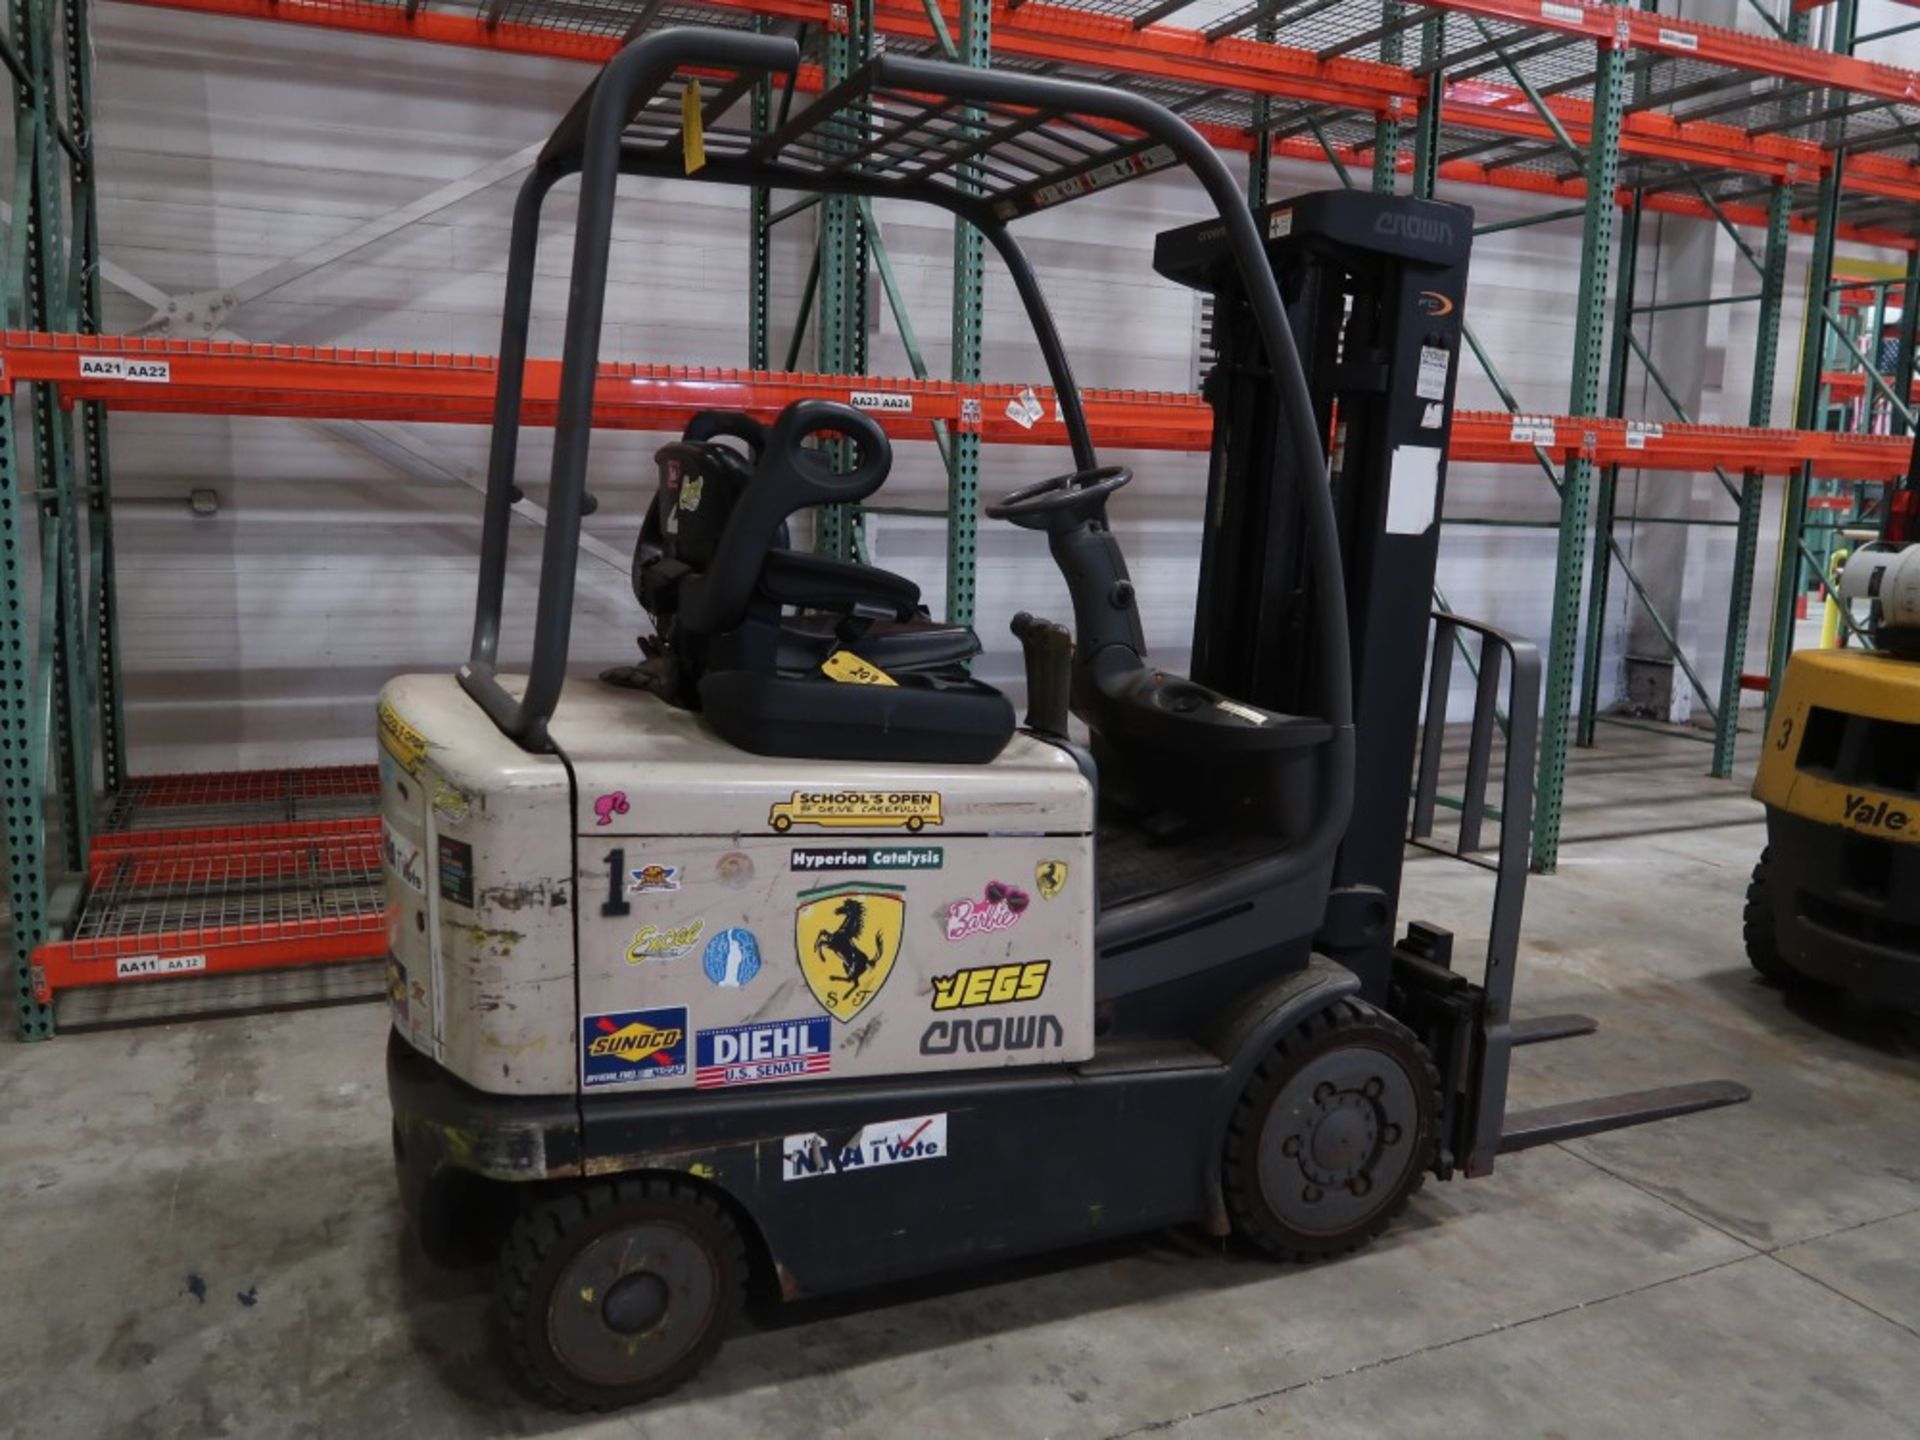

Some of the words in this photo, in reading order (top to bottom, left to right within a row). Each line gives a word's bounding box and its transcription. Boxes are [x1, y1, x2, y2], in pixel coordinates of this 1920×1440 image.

[1374, 211, 1454, 246] CROWN
[82, 362, 121, 374] AA21
[127, 366, 167, 377] AA22
[852, 396, 879, 406] AA23
[882, 398, 910, 408] AA24
[1776, 718, 1793, 751] 3
[800, 793, 883, 804] SCHOOL'S
[888, 793, 932, 804] OPEN
[818, 805, 855, 813] DRIVE
[1844, 794, 1909, 830] Yale
[792, 852, 867, 867] Hyperion
[873, 850, 940, 867] Catalysis
[603, 848, 630, 917] 1
[949, 900, 1019, 939] Barbie
[120, 960, 156, 973] AA11
[932, 960, 1051, 1012] JEGS
[595, 1030, 679, 1055] SUNOCO
[713, 1025, 818, 1065] DIEHL
[919, 1014, 1064, 1056] CROWN
[724, 1068, 752, 1083] U.S.
[756, 1060, 807, 1079] SENATE
[887, 1141, 938, 1160] Vote
